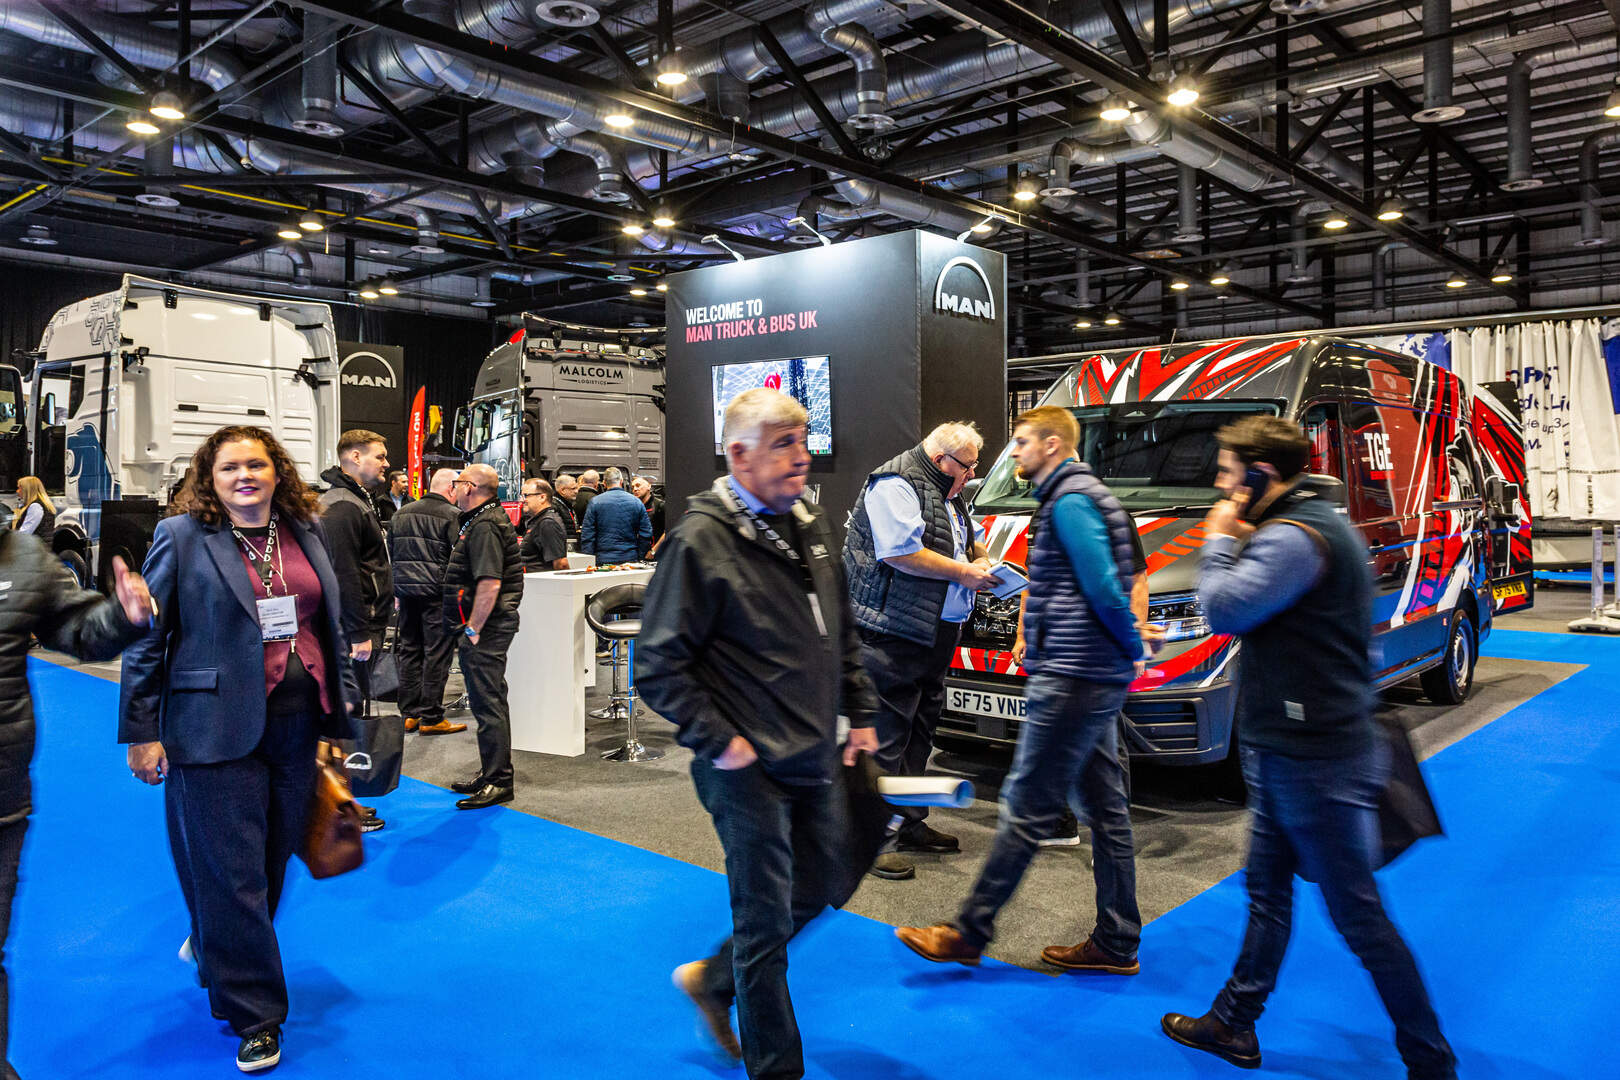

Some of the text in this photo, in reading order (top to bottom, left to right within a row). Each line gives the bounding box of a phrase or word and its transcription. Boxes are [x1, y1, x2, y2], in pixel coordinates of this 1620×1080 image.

[686, 299, 763, 325] WELCOME TO
[941, 292, 991, 319] MAN
[686, 310, 818, 343] MAN TRUCK & BUS UK
[341, 374, 391, 388] MAN
[560, 365, 623, 379] MALCOLM
[1363, 432, 1394, 470] TGE
[953, 691, 1028, 717] SF75 VNB
